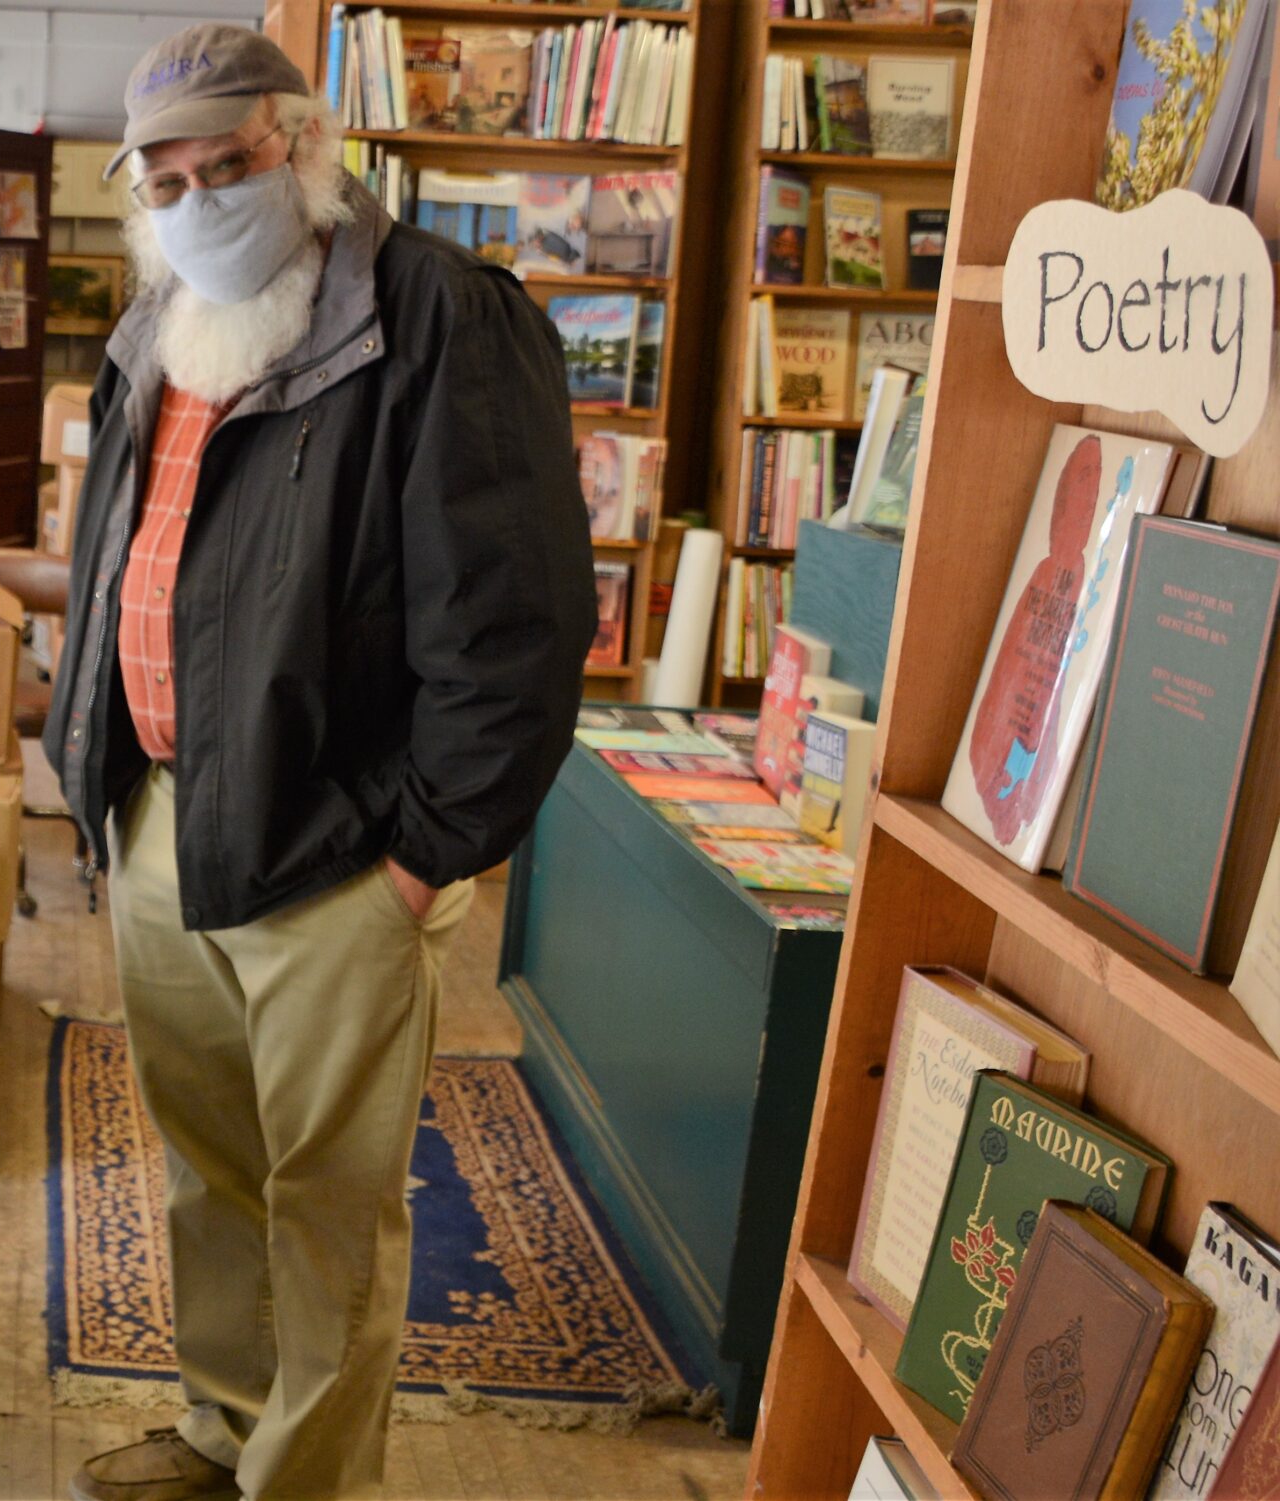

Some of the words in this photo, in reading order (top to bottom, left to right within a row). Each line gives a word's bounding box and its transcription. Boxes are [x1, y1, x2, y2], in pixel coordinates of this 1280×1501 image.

[776, 345, 836, 365] WOOD
[1037, 246, 1246, 424] Poetry
[911, 1051, 968, 1109] Notebo
[919, 1030, 941, 1053] THE
[940, 1038, 990, 1080] Esda
[990, 1096, 1126, 1191] MAURINE
